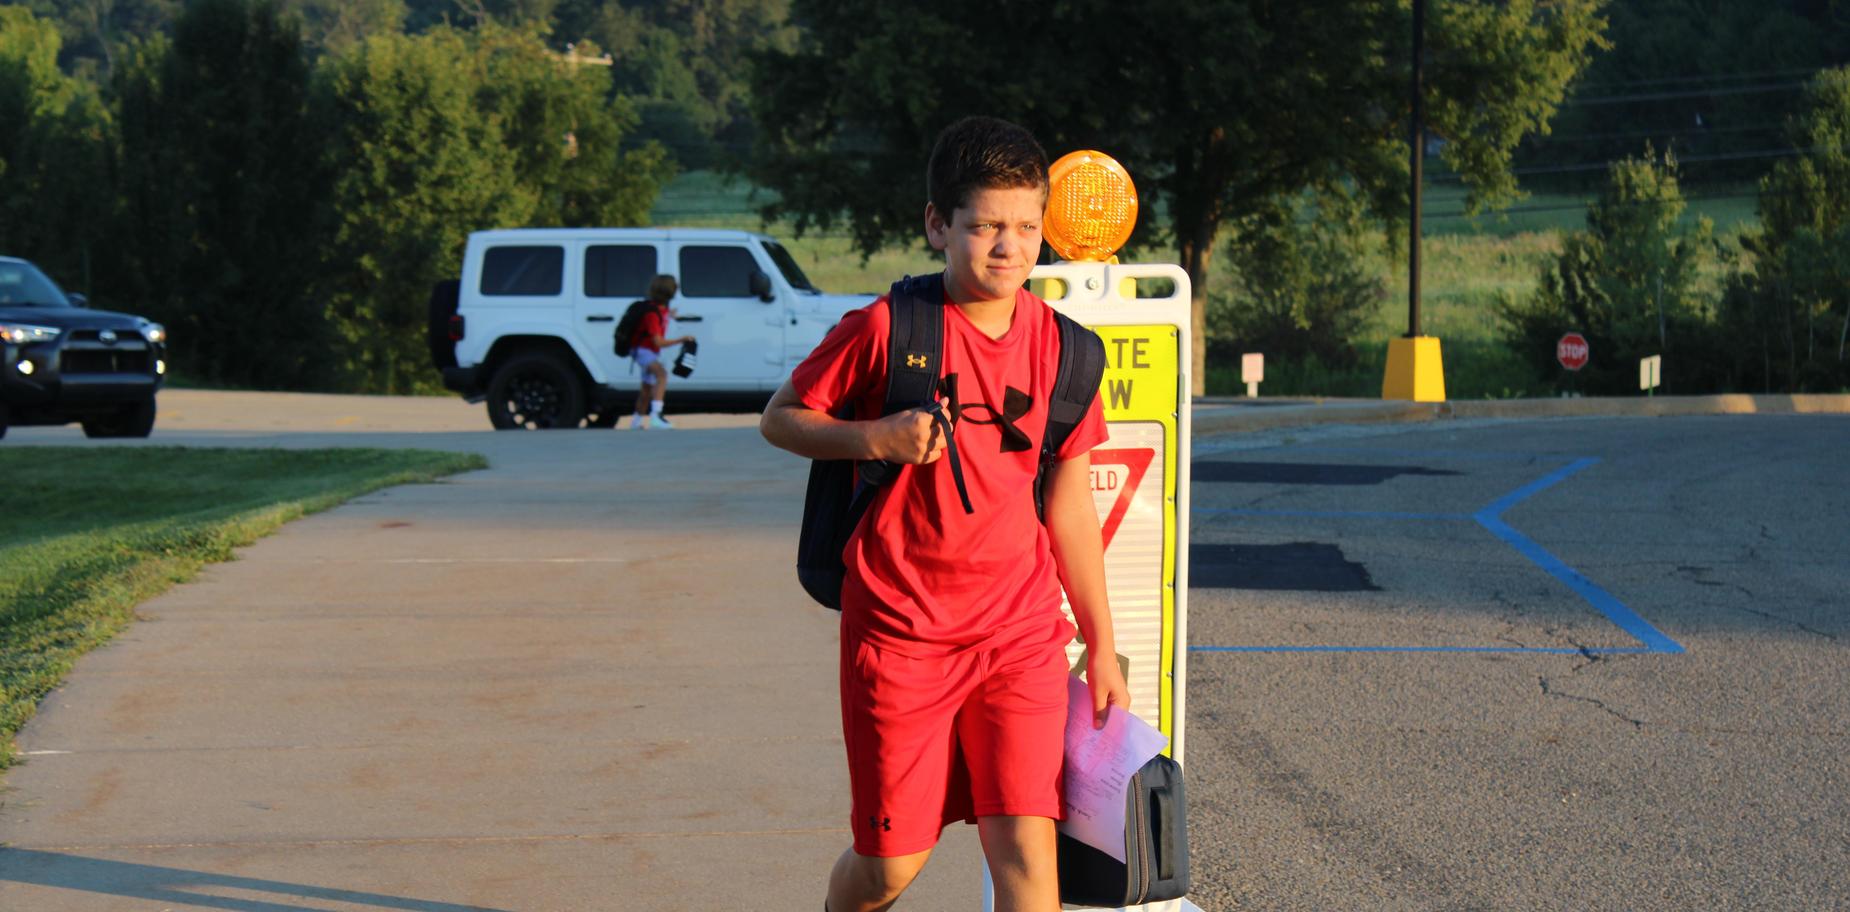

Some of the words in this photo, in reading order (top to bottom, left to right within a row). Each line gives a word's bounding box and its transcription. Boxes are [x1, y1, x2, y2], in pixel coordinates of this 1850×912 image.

[1105, 338, 1151, 369] TE
[1559, 343, 1586, 359] STOP
[1103, 379, 1133, 410] W
